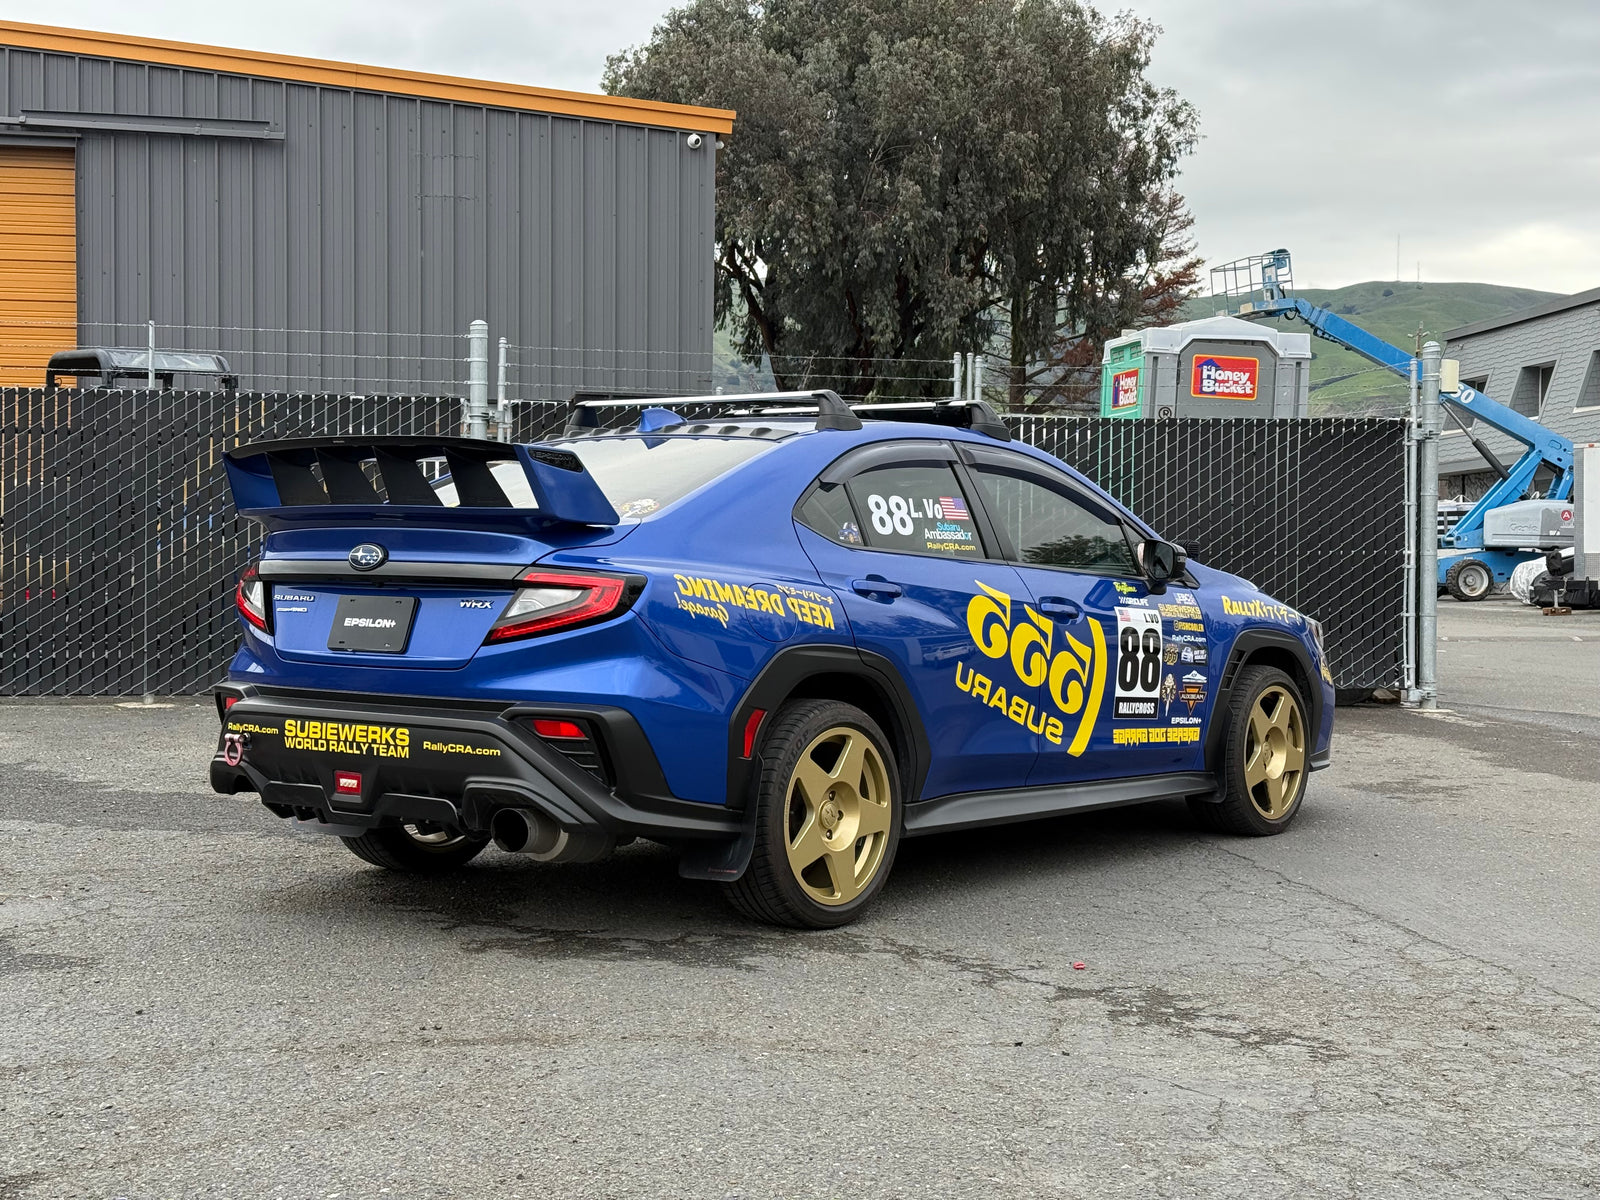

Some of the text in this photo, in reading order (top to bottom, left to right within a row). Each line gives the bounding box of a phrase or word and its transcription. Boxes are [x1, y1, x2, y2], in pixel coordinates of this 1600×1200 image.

[1202, 365, 1250, 384] Honey
[1119, 375, 1137, 390] Honey
[1202, 380, 1253, 394] Bucket
[1119, 389, 1137, 406] Bucket
[868, 494, 914, 536] 88
[909, 498, 943, 519] L. Vo
[936, 522, 961, 531] Subaru
[924, 528, 972, 540] Ambassador
[926, 542, 976, 551] RallyCRA.com
[273, 594, 314, 602] SUBARU
[459, 599, 494, 609] WRX
[344, 617, 396, 628] EPSILON+
[1118, 626, 1162, 692] 88
[1118, 702, 1155, 714] RALLYCROSS
[228, 722, 279, 735] RallyCRA.com
[284, 719, 410, 746] SUBIEWERKS
[284, 737, 410, 758] WORLD RALLY TEAM
[423, 741, 501, 756] RallyCRA.com
